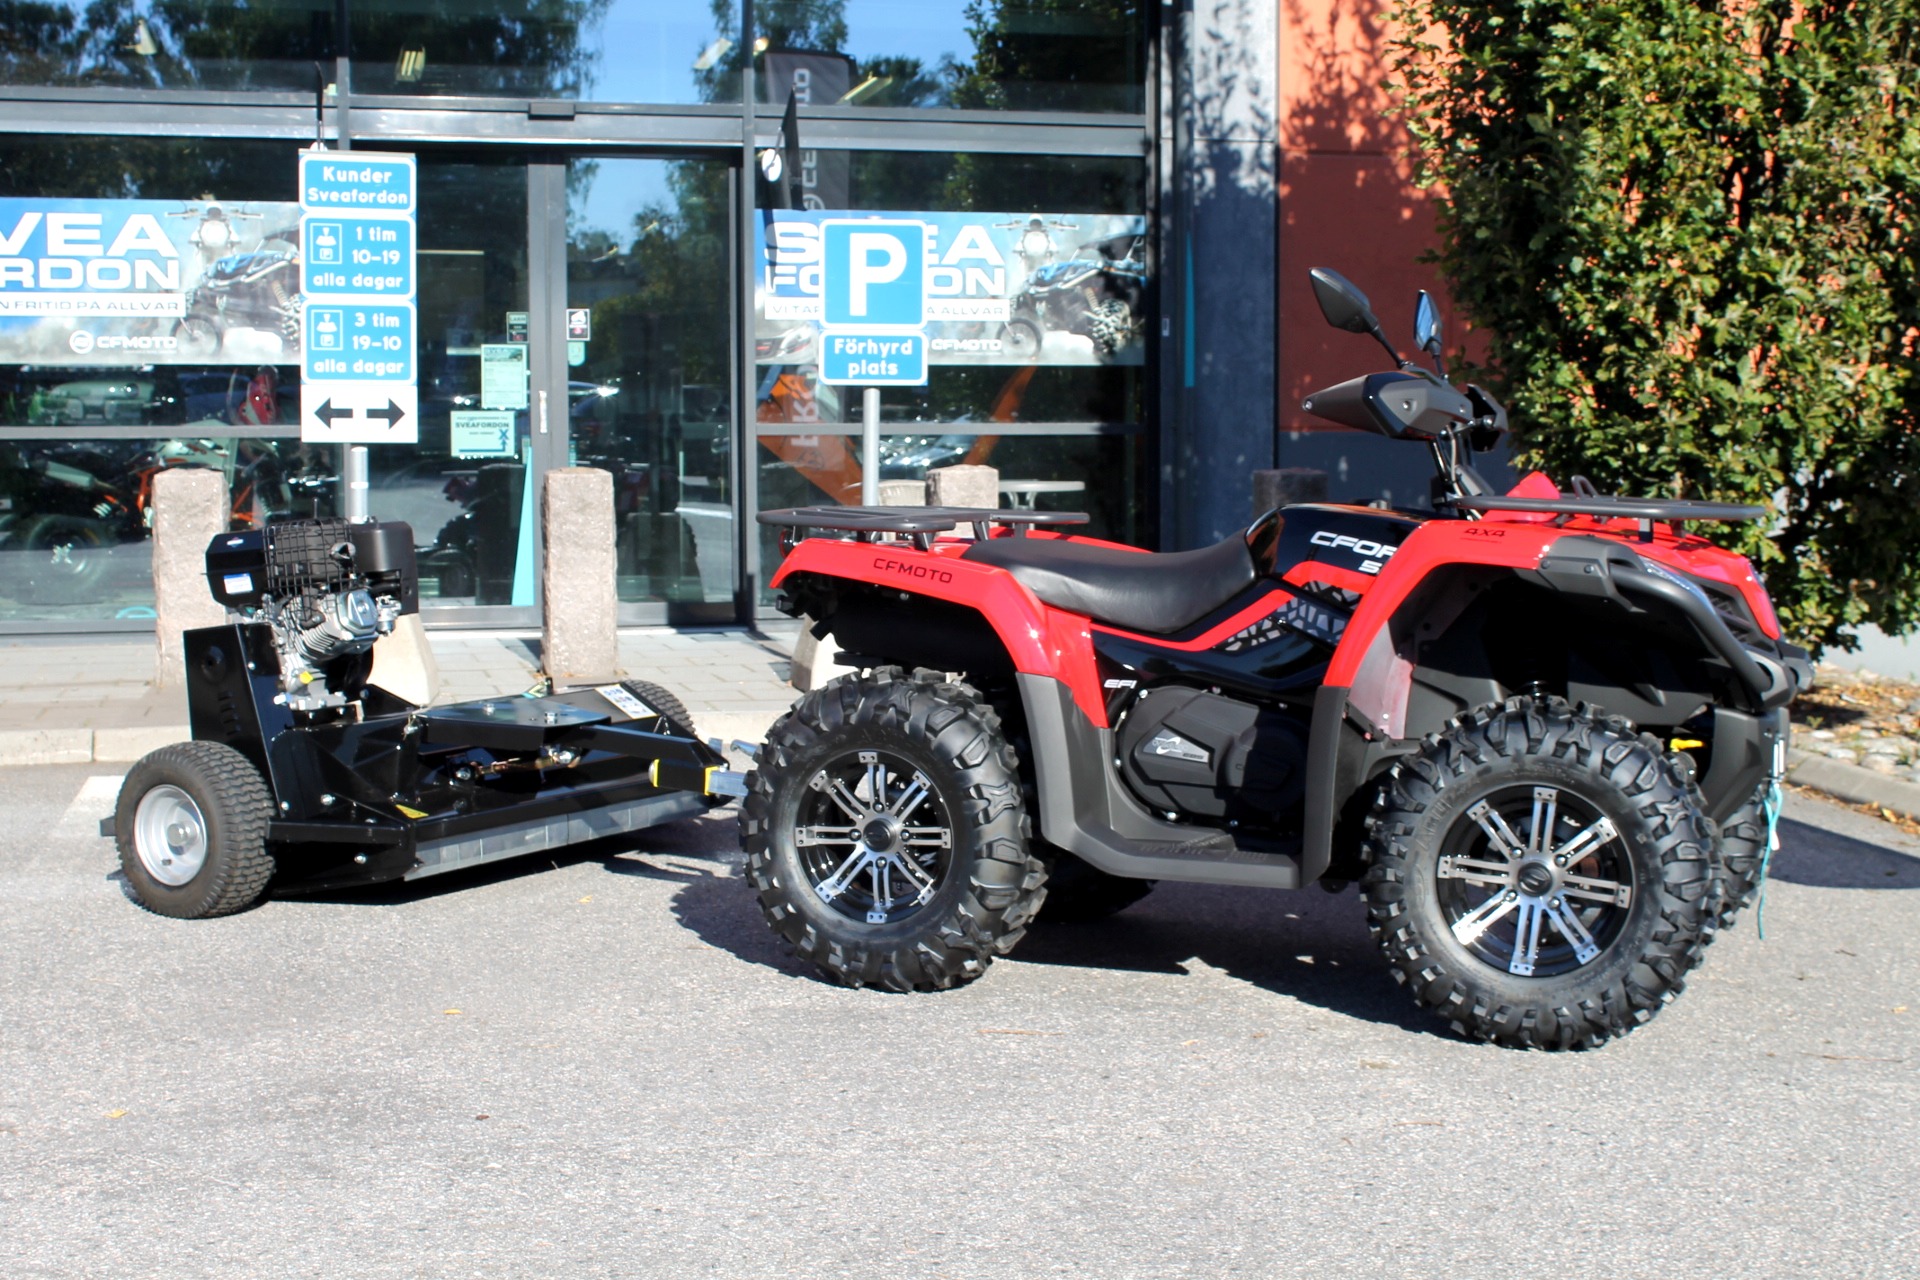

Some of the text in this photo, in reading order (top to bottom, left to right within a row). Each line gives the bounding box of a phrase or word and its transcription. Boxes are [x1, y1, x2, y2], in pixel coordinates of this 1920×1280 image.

[323, 166, 393, 183] Kunder
[308, 187, 408, 204] Sveafordon
[356, 226, 397, 242] 1 tim
[313, 272, 403, 291] alla dagar
[850, 232, 907, 317] P
[15, 301, 72, 310] FRITID
[107, 302, 179, 311] ALLVAR
[941, 307, 1004, 316] ALLVAR
[354, 312, 400, 328] 3 tim
[97, 336, 178, 349] CFMOTO
[834, 338, 913, 358] Förhyrd
[931, 339, 1002, 351] CFMOTO
[313, 359, 404, 377] alla dagar
[848, 359, 899, 378] plats
[455, 421, 510, 429] SVEAFORDON
[873, 558, 953, 584] CFMOTO
[1104, 679, 1137, 689] EFI
